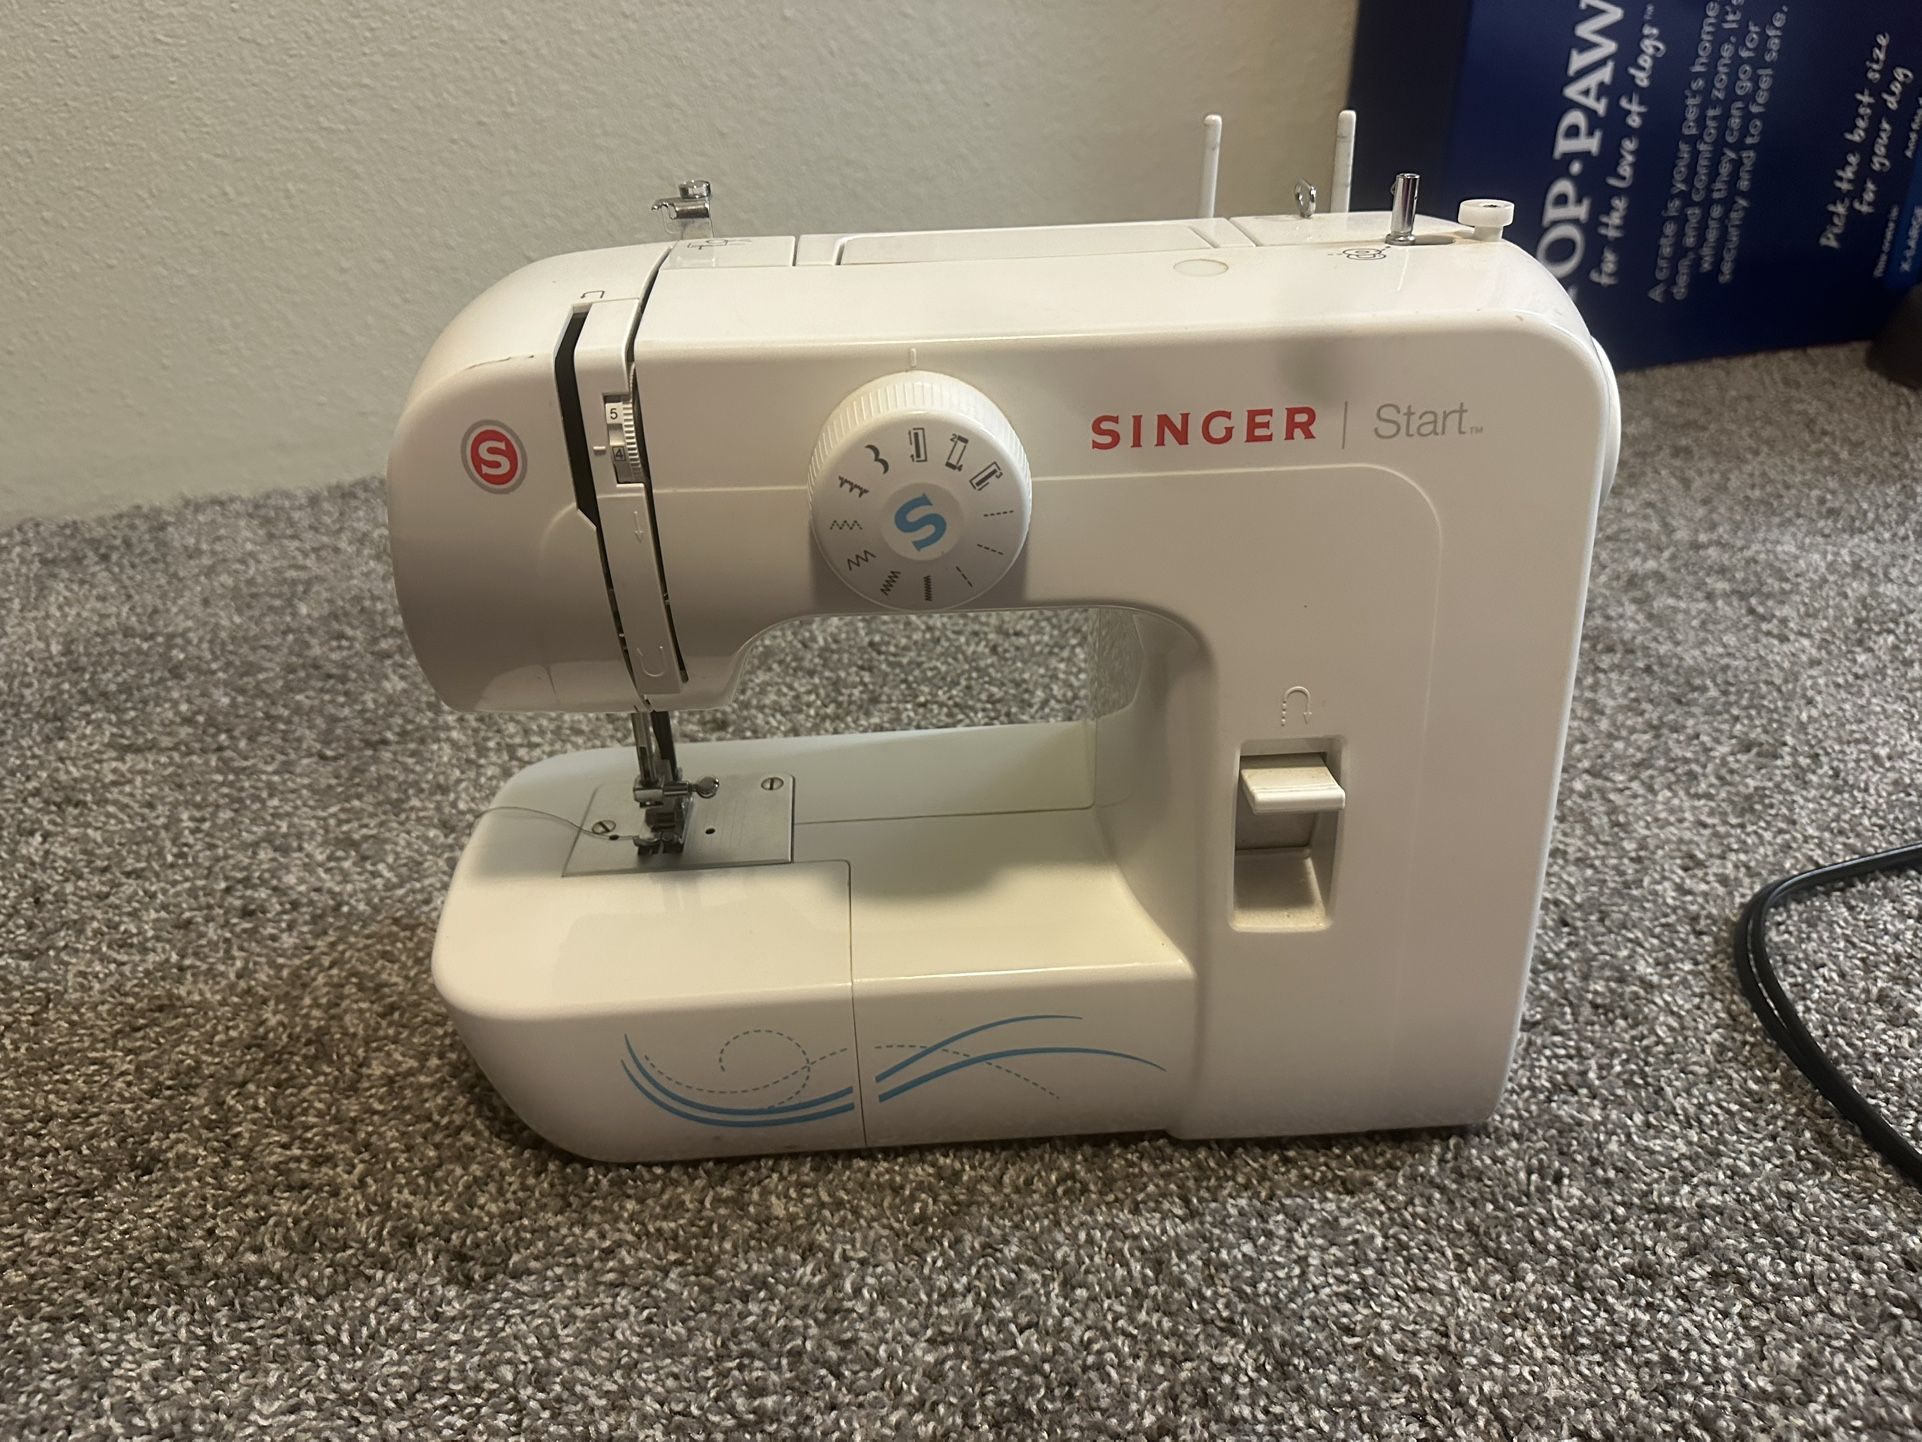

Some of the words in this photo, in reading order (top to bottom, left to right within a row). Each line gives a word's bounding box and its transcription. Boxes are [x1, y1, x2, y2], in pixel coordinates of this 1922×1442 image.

[1738, 21, 1761, 58] for
[1764, 5, 1788, 62] safe.
[1711, 35, 1737, 100] zone.
[1735, 64, 1753, 96] go
[1865, 32, 1890, 83] size
[1619, 92, 1648, 128] of
[1682, 78, 1705, 135] pet's
[1748, 68, 1774, 113] feel
[1725, 101, 1745, 143] can
[1744, 118, 1762, 144] to
[1843, 87, 1875, 143] best
[1691, 104, 1722, 202] comfort
[1852, 178, 1878, 215] for
[1870, 116, 1891, 172] your
[1881, 66, 1914, 110] dog
[1670, 140, 1693, 194] your
[1711, 148, 1739, 199] they
[1736, 150, 1757, 191] and
[1833, 152, 1860, 193] the
[1597, 195, 1630, 241] the
[1661, 198, 1681, 217] is
[1682, 206, 1702, 248] and
[1819, 197, 1850, 248] Pick
[1655, 220, 1678, 280] crate
[1699, 203, 1725, 273] where
[1718, 196, 1750, 284] security
[1589, 246, 1619, 286] for
[1648, 283, 1668, 303] A
[610, 408, 618, 420] 5
[1091, 406, 1318, 450] SINGER
[478, 440, 511, 475] S
[615, 449, 624, 458] 4
[894, 493, 947, 552] S
